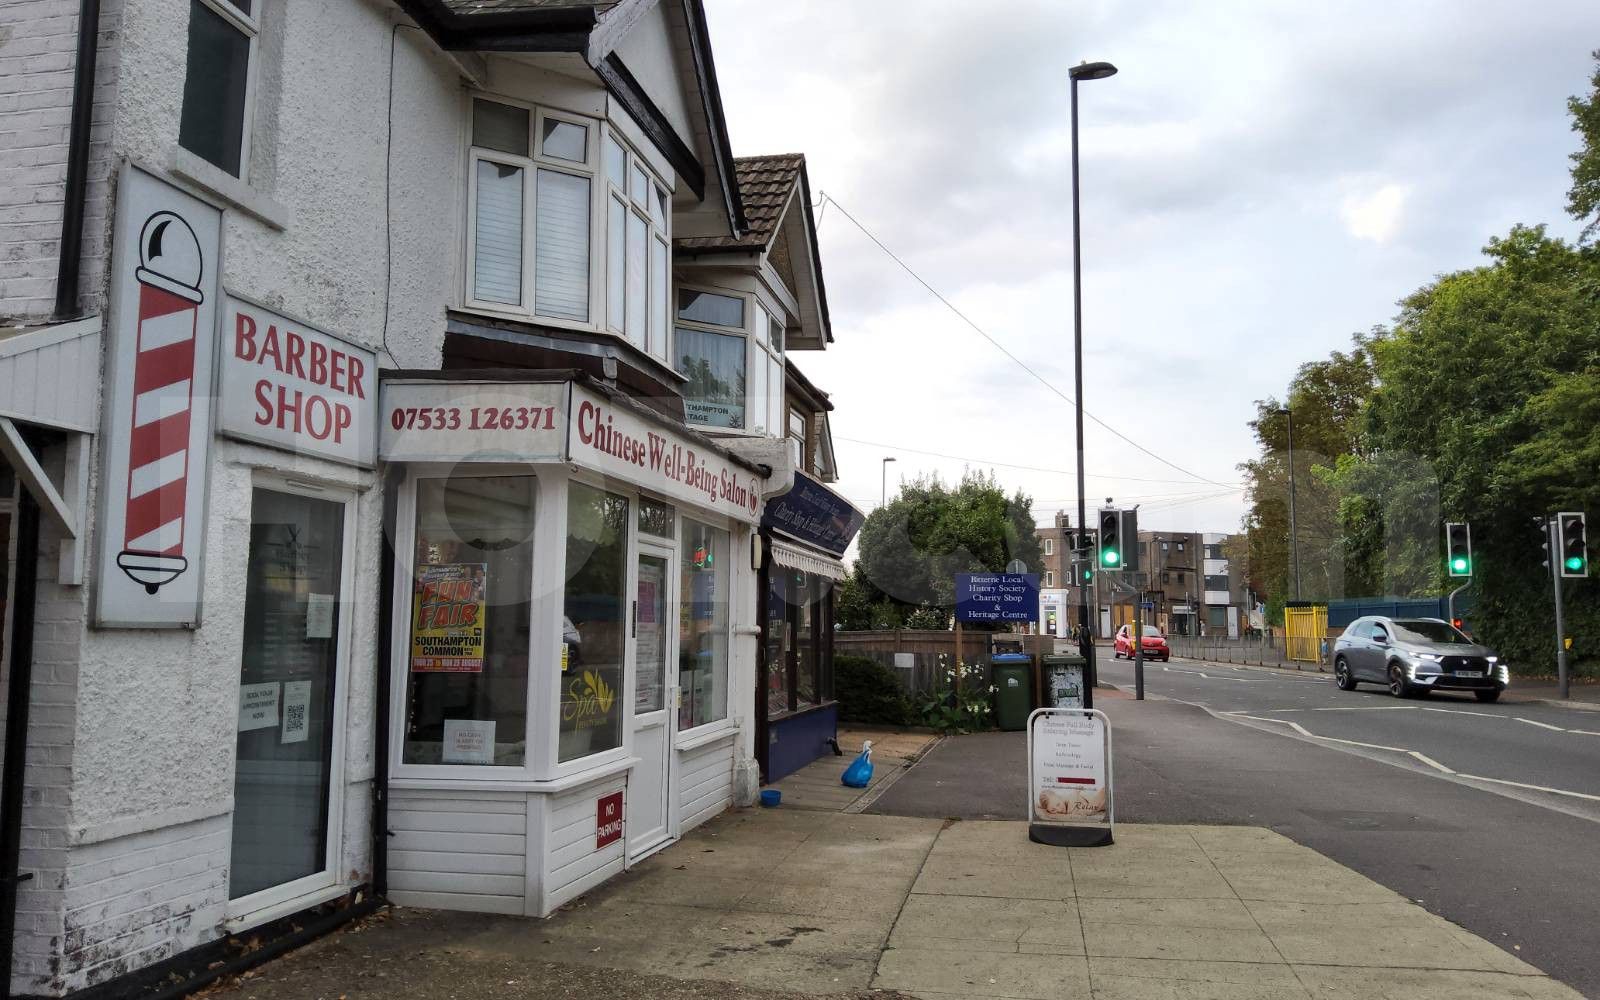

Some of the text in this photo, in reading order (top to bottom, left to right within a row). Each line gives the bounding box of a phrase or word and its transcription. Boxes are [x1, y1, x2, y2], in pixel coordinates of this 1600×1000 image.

[234, 313, 366, 400] BARBER
[255, 379, 352, 445] SHOP
[686, 404, 729, 415] THAMPTON
[391, 406, 556, 431] 07533 126371
[688, 413, 709, 422] TAGE
[578, 400, 647, 468] Chinese
[647, 430, 718, 503] Well-Being
[718, 467, 748, 508] Salon
[421, 580, 473, 604] FUN
[968, 584, 1026, 594] History Society
[972, 594, 1023, 603] Charity Shop
[418, 603, 478, 630] FAIR
[968, 611, 1000, 620] Heritage
[415, 636, 482, 647] SOUTHAMPTON
[422, 646, 464, 656] COMMON
[605, 803, 615, 817] NO
[598, 819, 621, 839] PARKING
